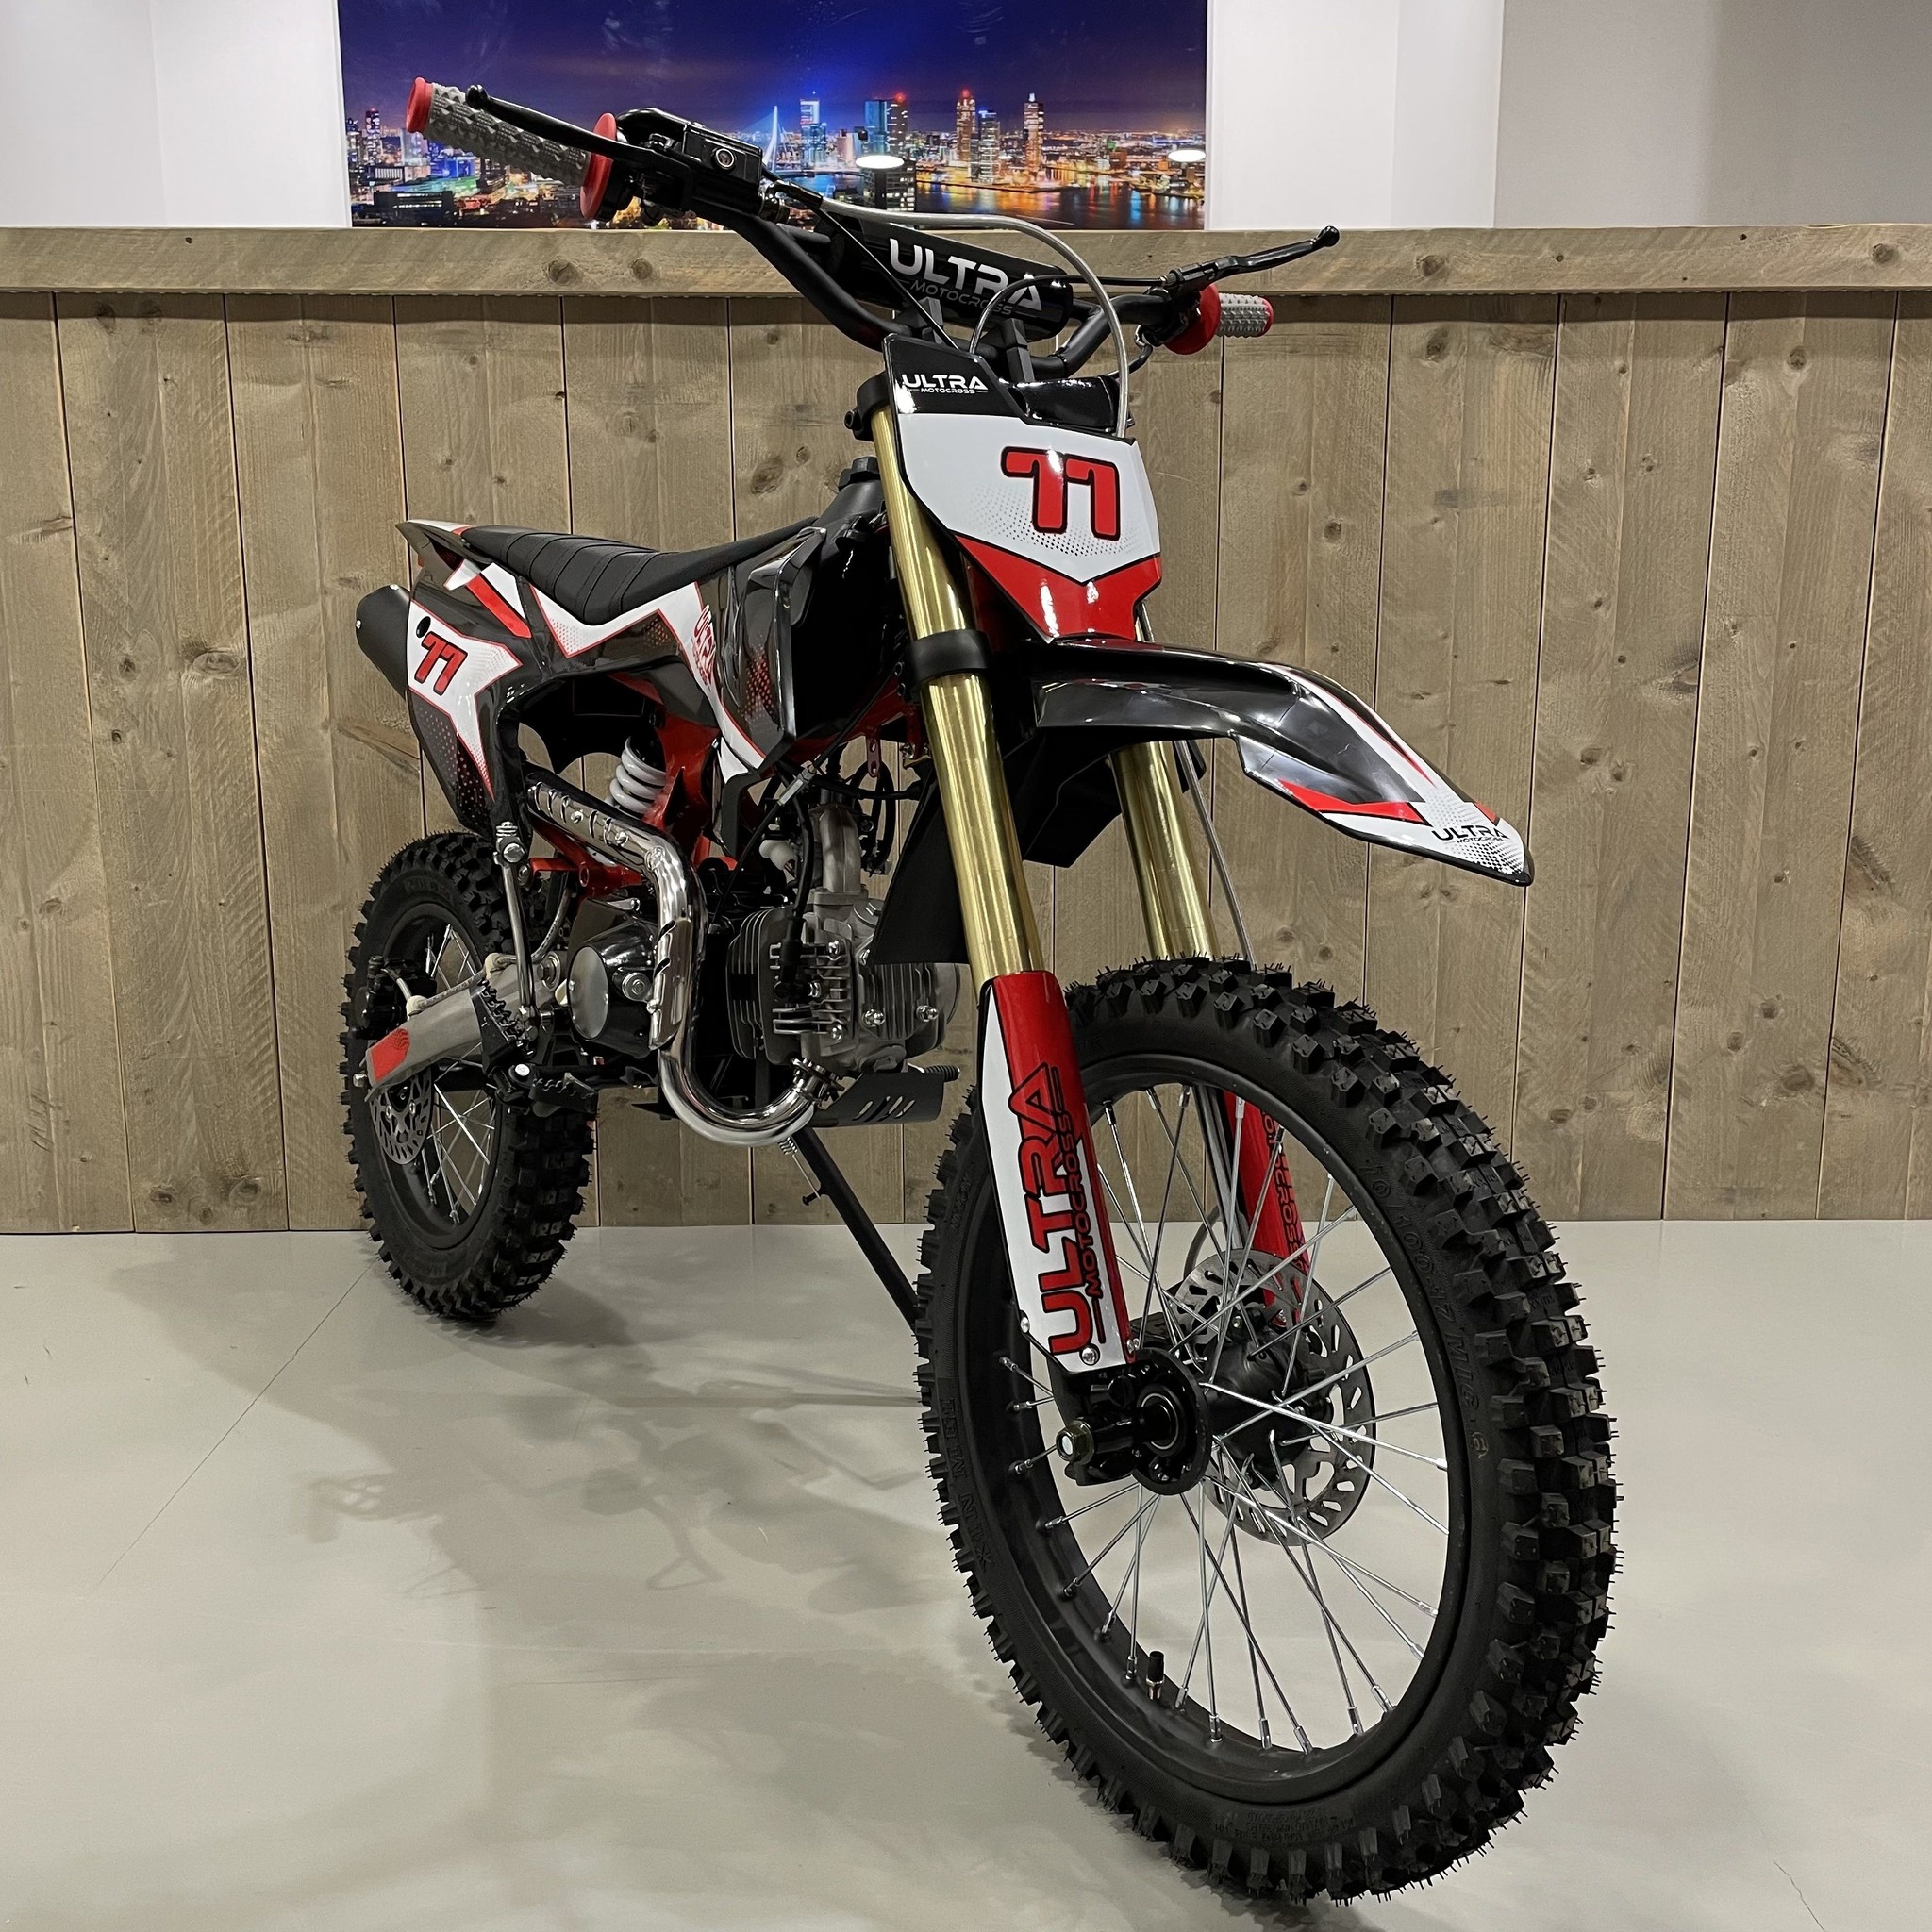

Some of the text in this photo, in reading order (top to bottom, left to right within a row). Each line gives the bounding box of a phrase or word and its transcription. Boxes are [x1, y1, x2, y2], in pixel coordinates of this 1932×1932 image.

[890, 238, 1042, 311] ULTRA
[910, 280, 1014, 315] MOTOCROSS
[902, 374, 989, 391] ULTRA
[1000, 446, 1121, 542] 77
[413, 630, 468, 696] 77
[1431, 825, 1510, 841] ULTRA
[1008, 1062, 1093, 1356] ULTRA
[1058, 1111, 1104, 1299] MOTOCROSS
